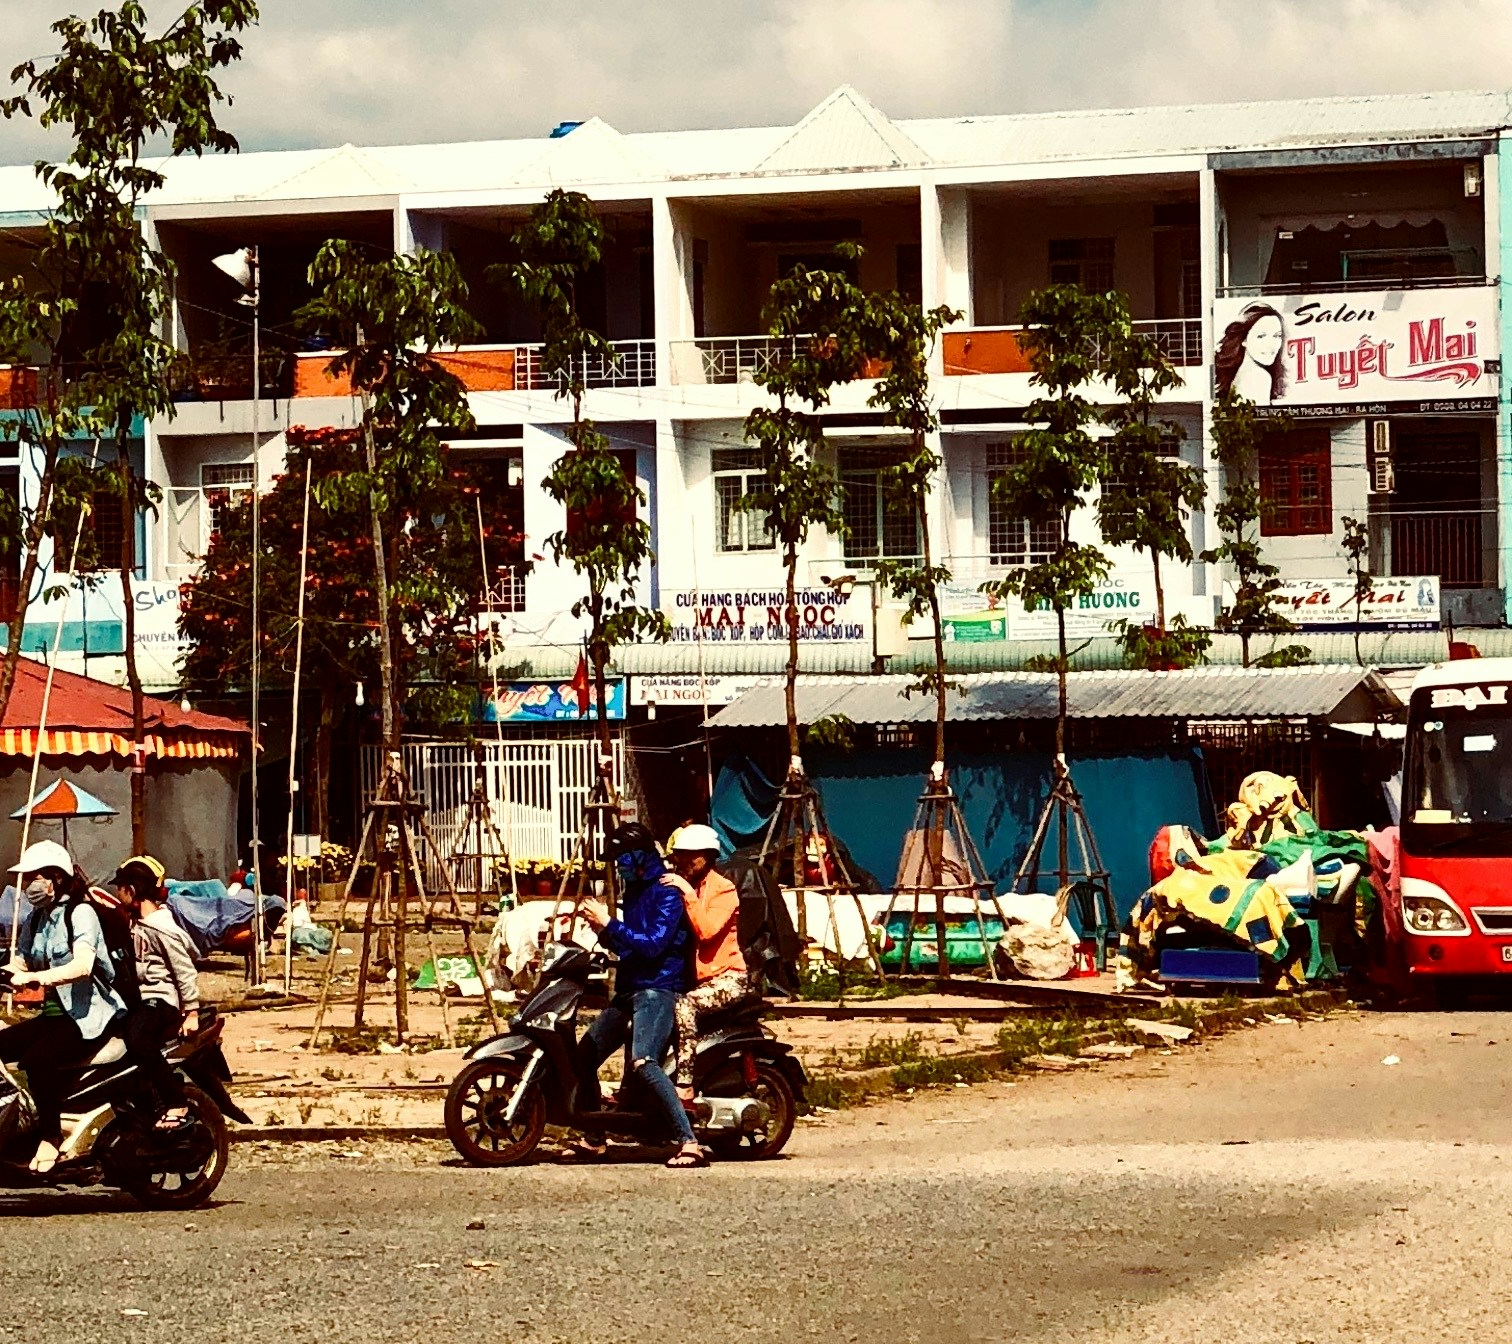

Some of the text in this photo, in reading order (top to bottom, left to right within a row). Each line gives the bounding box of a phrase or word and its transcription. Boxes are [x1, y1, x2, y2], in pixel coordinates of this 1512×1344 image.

[1294, 302, 1377, 326] Salon
[1287, 317, 1479, 391] Tuyết Mai
[735, 589, 766, 606] BÁCH
[694, 607, 745, 627] MAI
